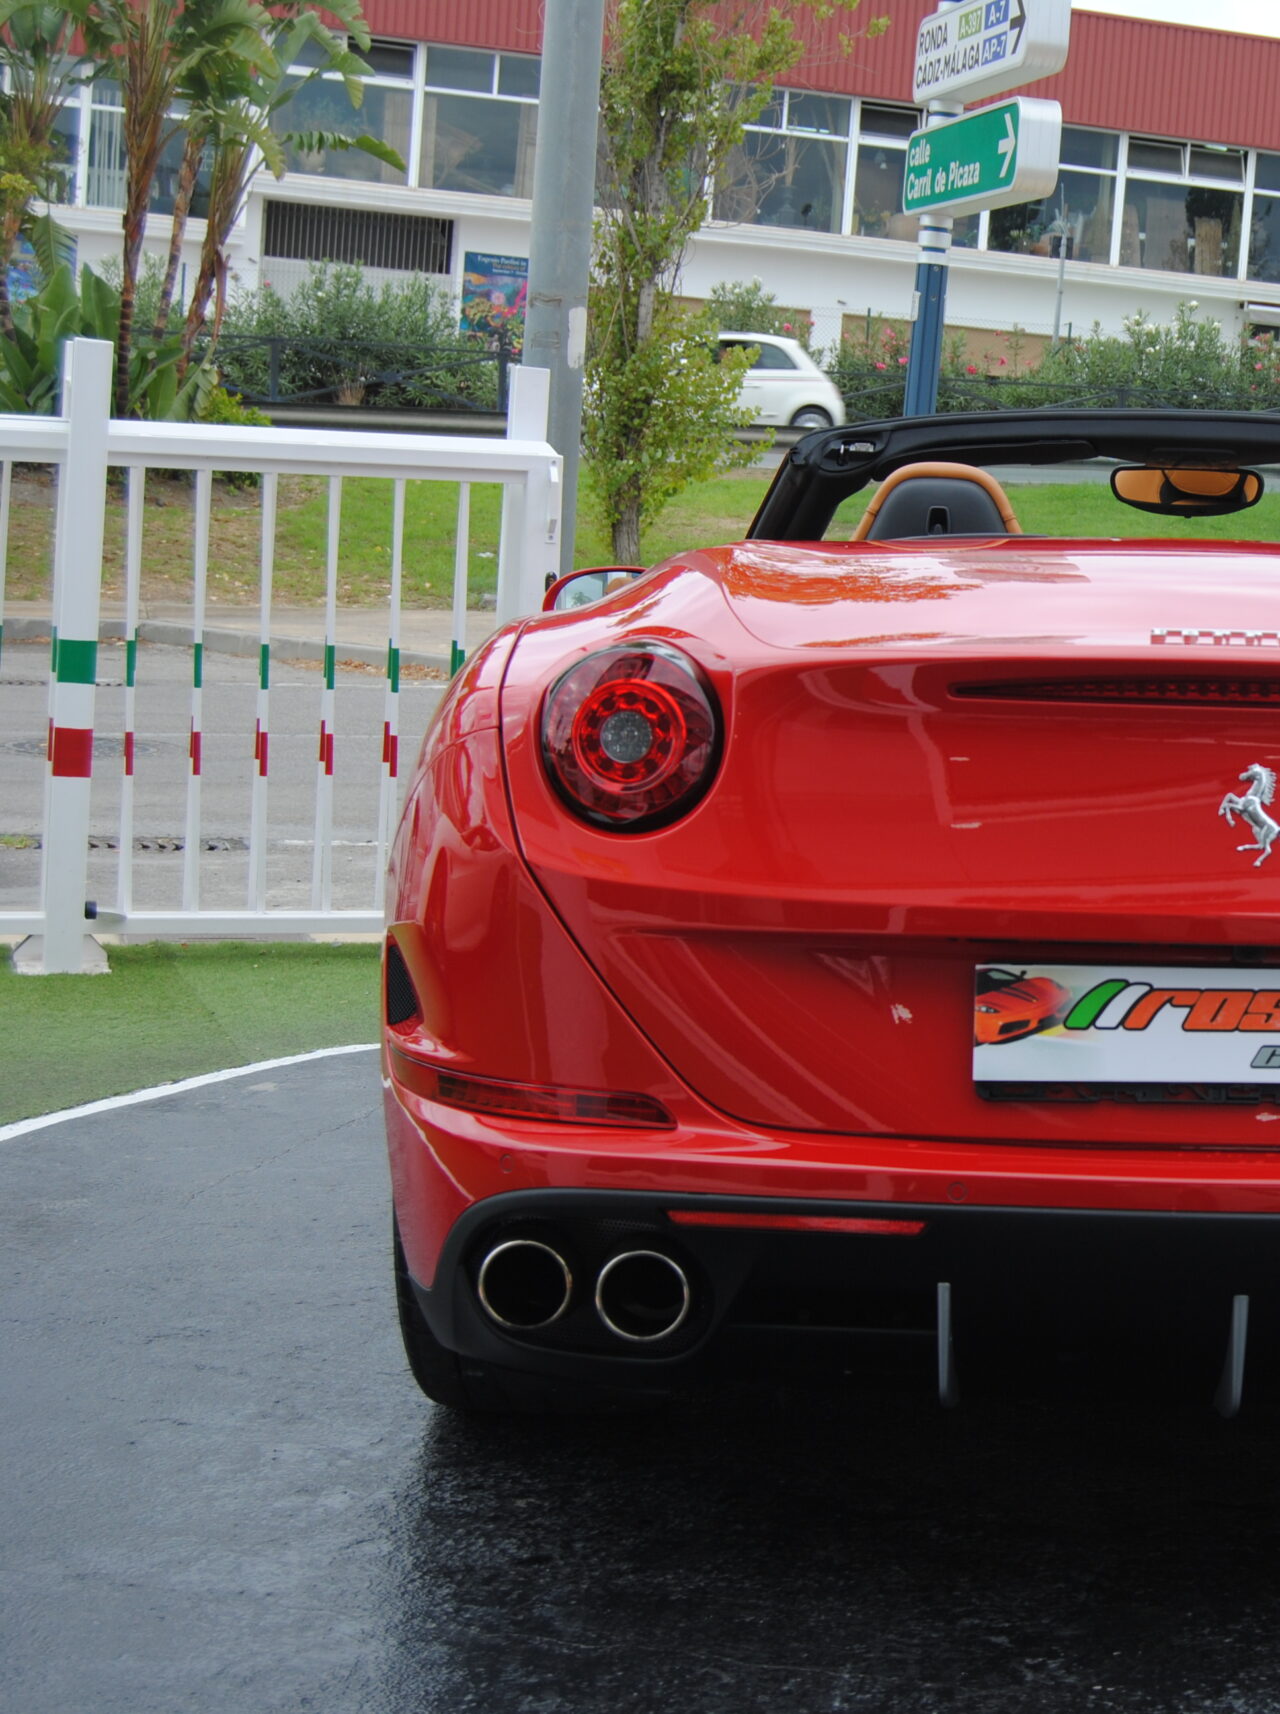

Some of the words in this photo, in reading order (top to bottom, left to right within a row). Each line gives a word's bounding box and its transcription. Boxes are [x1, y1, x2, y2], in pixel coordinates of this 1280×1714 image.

[988, 2, 1005, 26] A-7
[918, 22, 948, 57] RONDA
[959, 11, 982, 37] A-397
[916, 42, 980, 89] CÁDIZ-MÁLAGA
[982, 36, 1007, 62] AP-7
[909, 139, 931, 166] calle
[907, 168, 931, 200] Carril
[934, 168, 946, 193] de
[948, 161, 980, 190] Picaza
